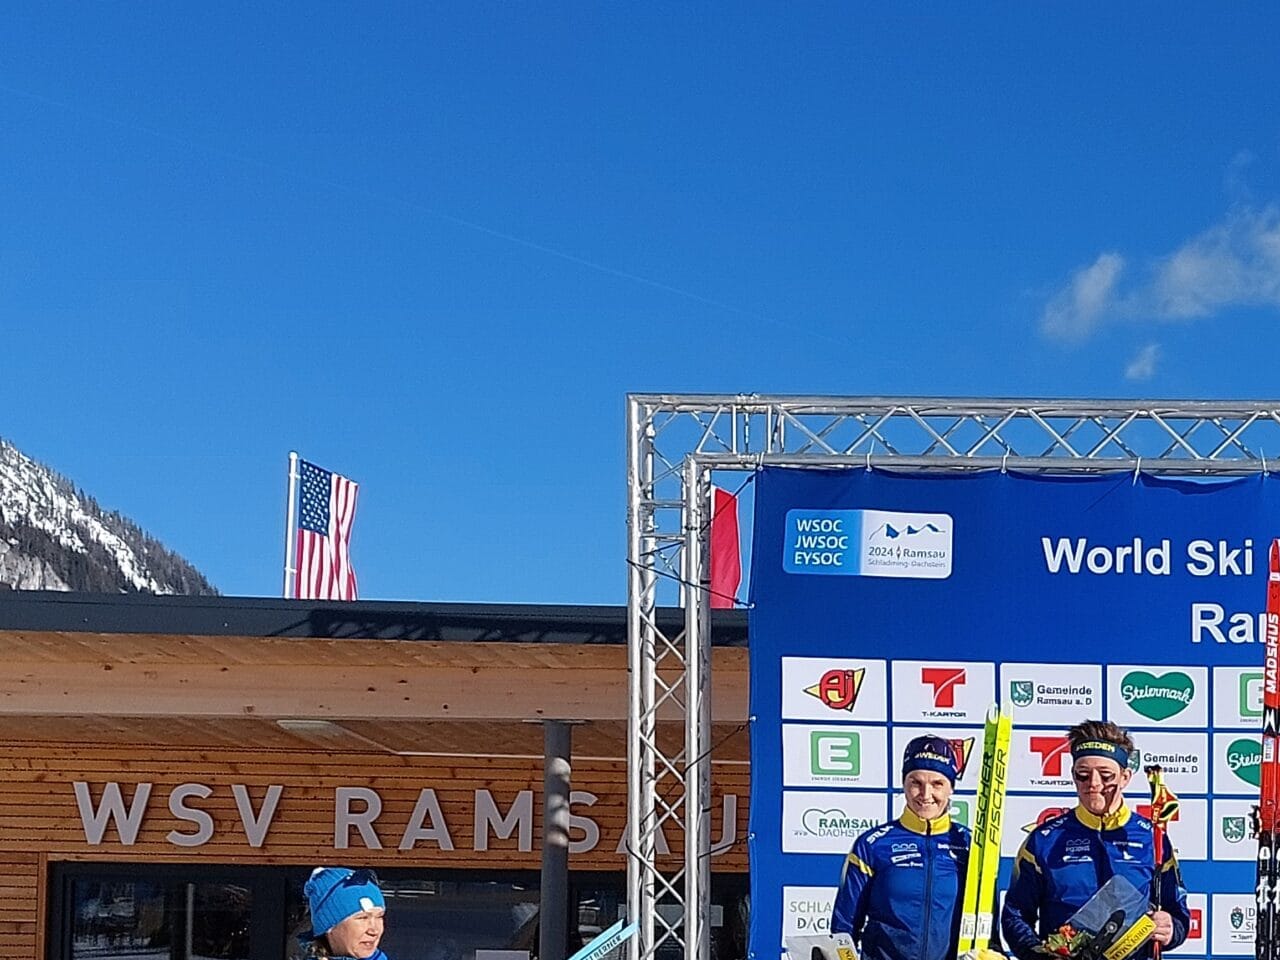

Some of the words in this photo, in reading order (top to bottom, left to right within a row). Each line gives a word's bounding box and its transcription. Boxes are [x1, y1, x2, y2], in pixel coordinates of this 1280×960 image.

[796, 519, 842, 532] WSOC
[795, 536, 848, 549] JWSOC
[795, 552, 843, 566] EYSOC
[868, 546, 894, 558] 2024
[903, 548, 946, 559] Ramsau
[1042, 537, 1170, 576] World
[1187, 539, 1253, 576] Ski
[1266, 613, 1279, 694] MADSHUS
[1037, 685, 1092, 695] Gemeinde
[1123, 685, 1192, 703] Steiermark
[1037, 697, 1073, 706] Ramsau
[1144, 753, 1198, 763] Gemeinde
[974, 751, 993, 848] FISCHER
[990, 748, 1007, 846] FISCHER
[73, 781, 283, 848] WSV
[818, 818, 879, 828] RAMSAU
